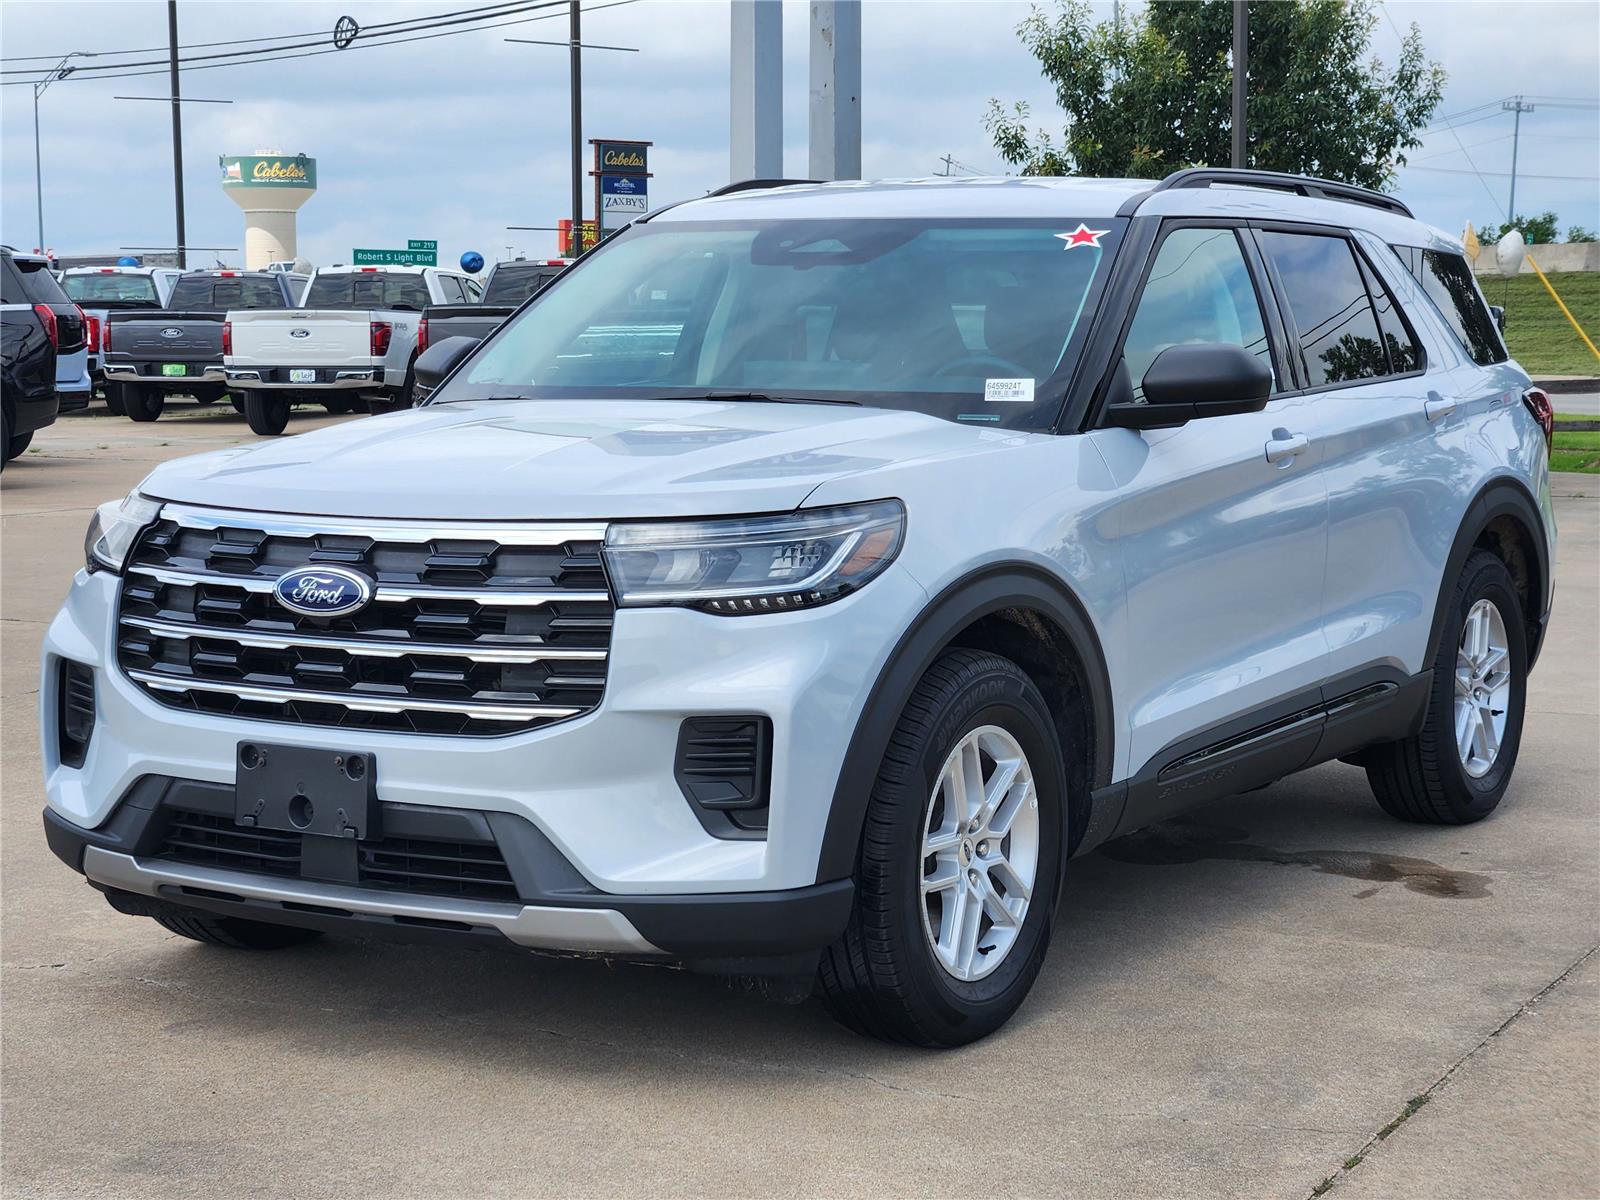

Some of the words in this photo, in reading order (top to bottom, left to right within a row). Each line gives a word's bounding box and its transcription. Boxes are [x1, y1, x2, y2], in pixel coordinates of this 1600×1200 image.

[604, 150, 644, 167] Cabela's
[604, 197, 645, 209] ZAXBY'S
[357, 253, 384, 261] Robert
[386, 253, 392, 261] S
[394, 253, 413, 263] Light
[416, 254, 433, 262] Blvd
[986, 382, 1022, 390] 6459924T
[292, 576, 345, 605] Ford
